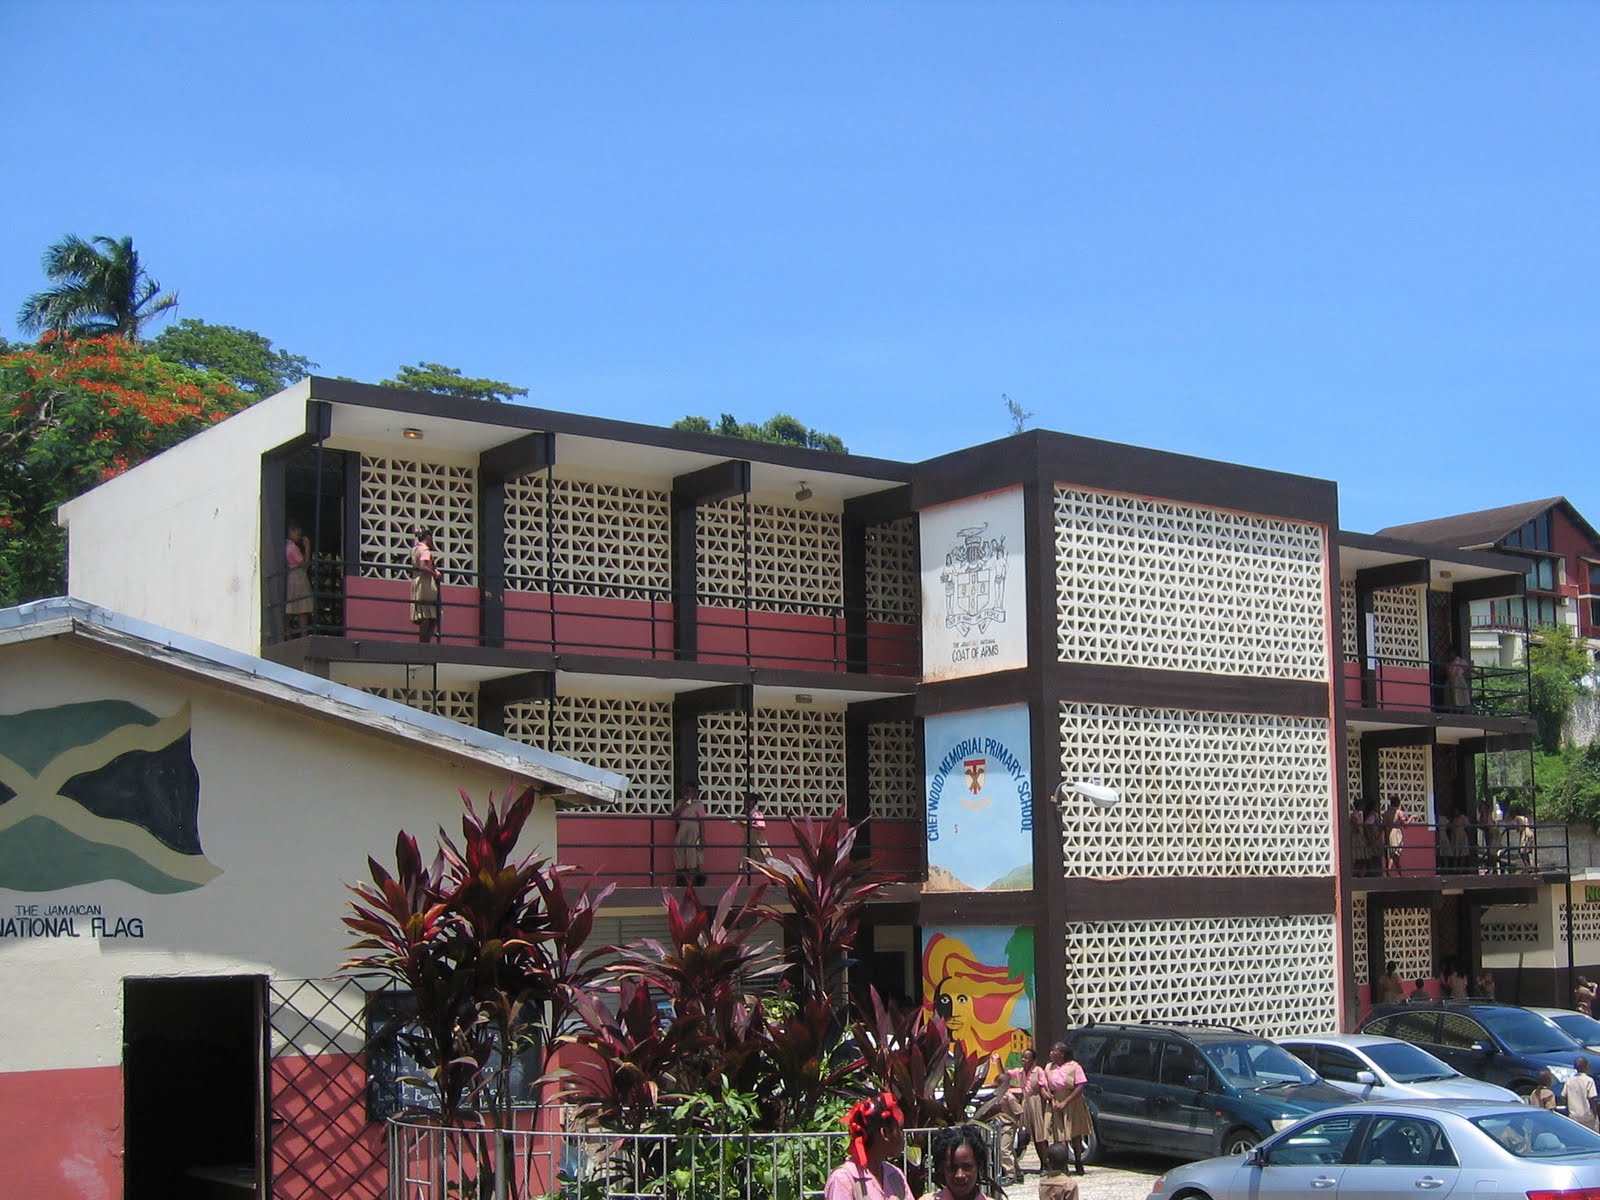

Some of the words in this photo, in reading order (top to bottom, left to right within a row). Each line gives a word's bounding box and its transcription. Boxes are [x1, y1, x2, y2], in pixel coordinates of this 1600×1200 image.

[952, 648, 970, 663] COAT
[971, 647, 979, 659] OF
[980, 644, 999, 658] ARMS
[928, 773, 945, 842] CHETWOOD
[939, 737, 983, 780] MEMORIAL
[984, 737, 1026, 782] PRIMARY
[1017, 780, 1033, 834] SCHOOL
[15, 904, 39, 916] THE
[44, 904, 102, 916] JAMAICAN
[91, 917, 144, 939] FLAG
